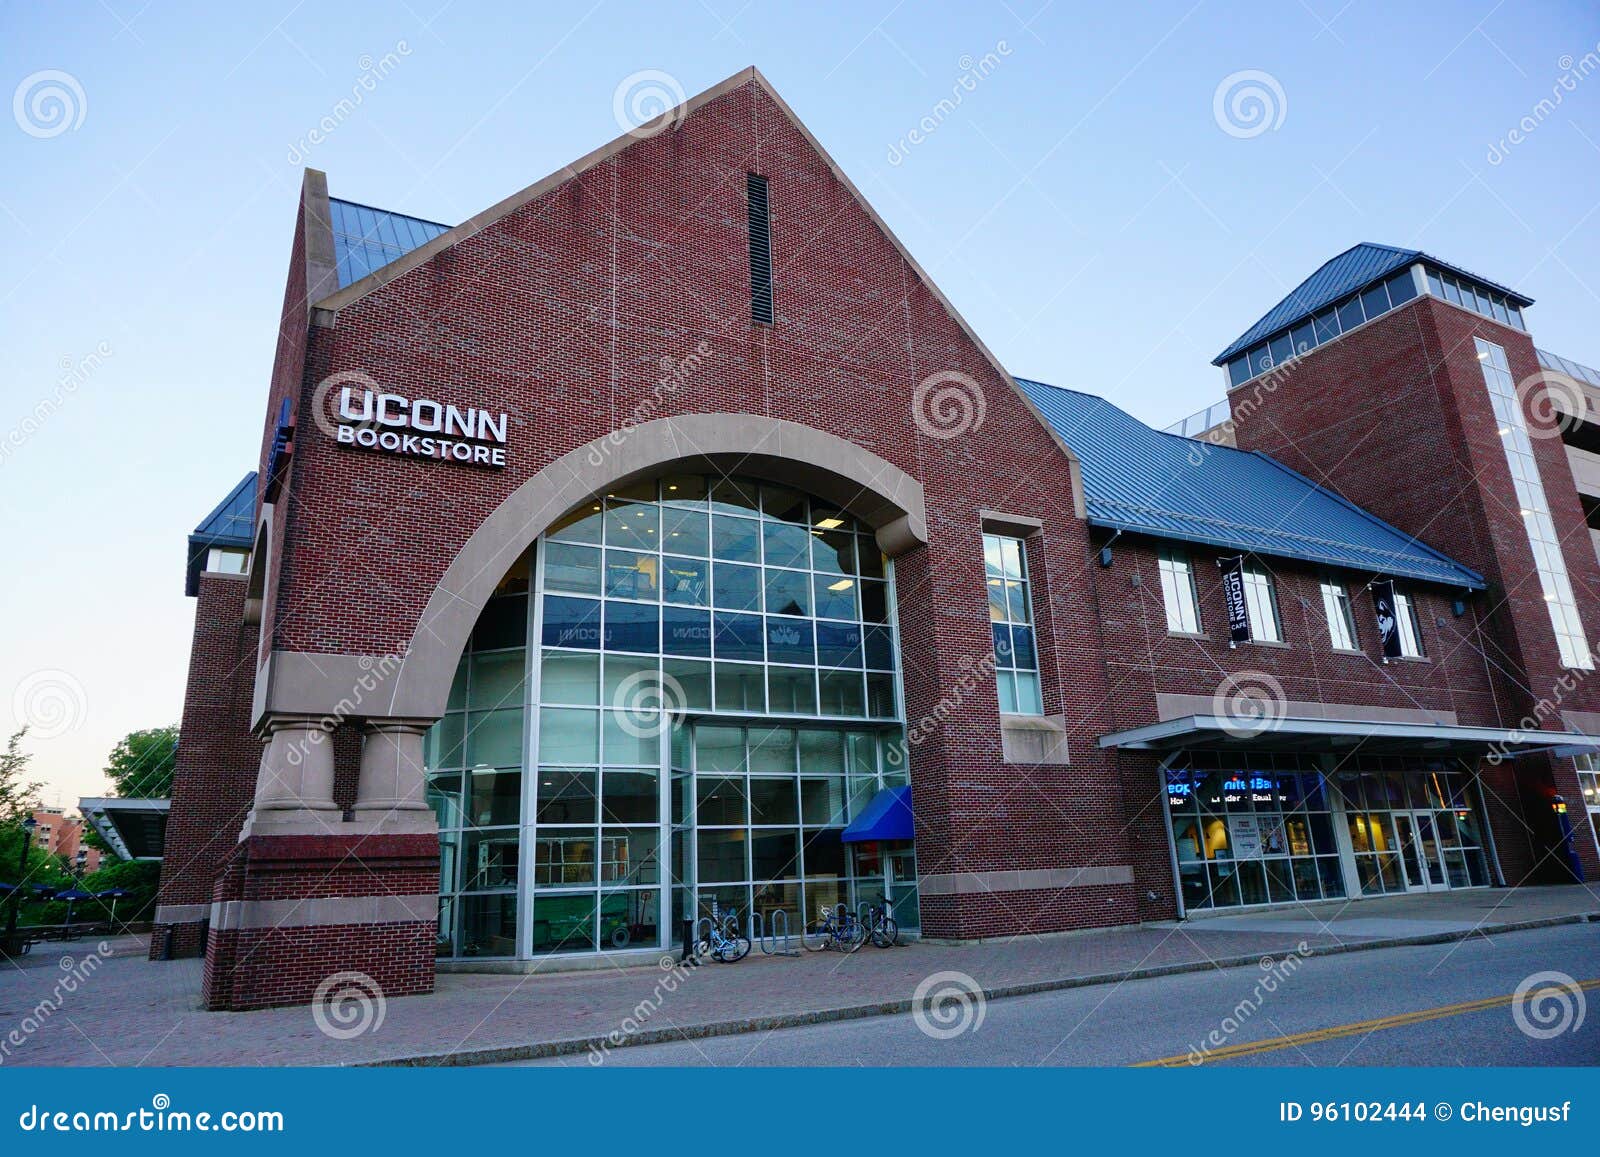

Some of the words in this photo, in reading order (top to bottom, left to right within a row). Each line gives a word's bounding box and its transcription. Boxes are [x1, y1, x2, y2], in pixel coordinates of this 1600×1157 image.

[340, 387, 508, 442] UCONN
[337, 425, 506, 466] BOOKSTORE
[1223, 574, 1236, 622] BOOKSTORE
[1229, 571, 1246, 621] UCONN
